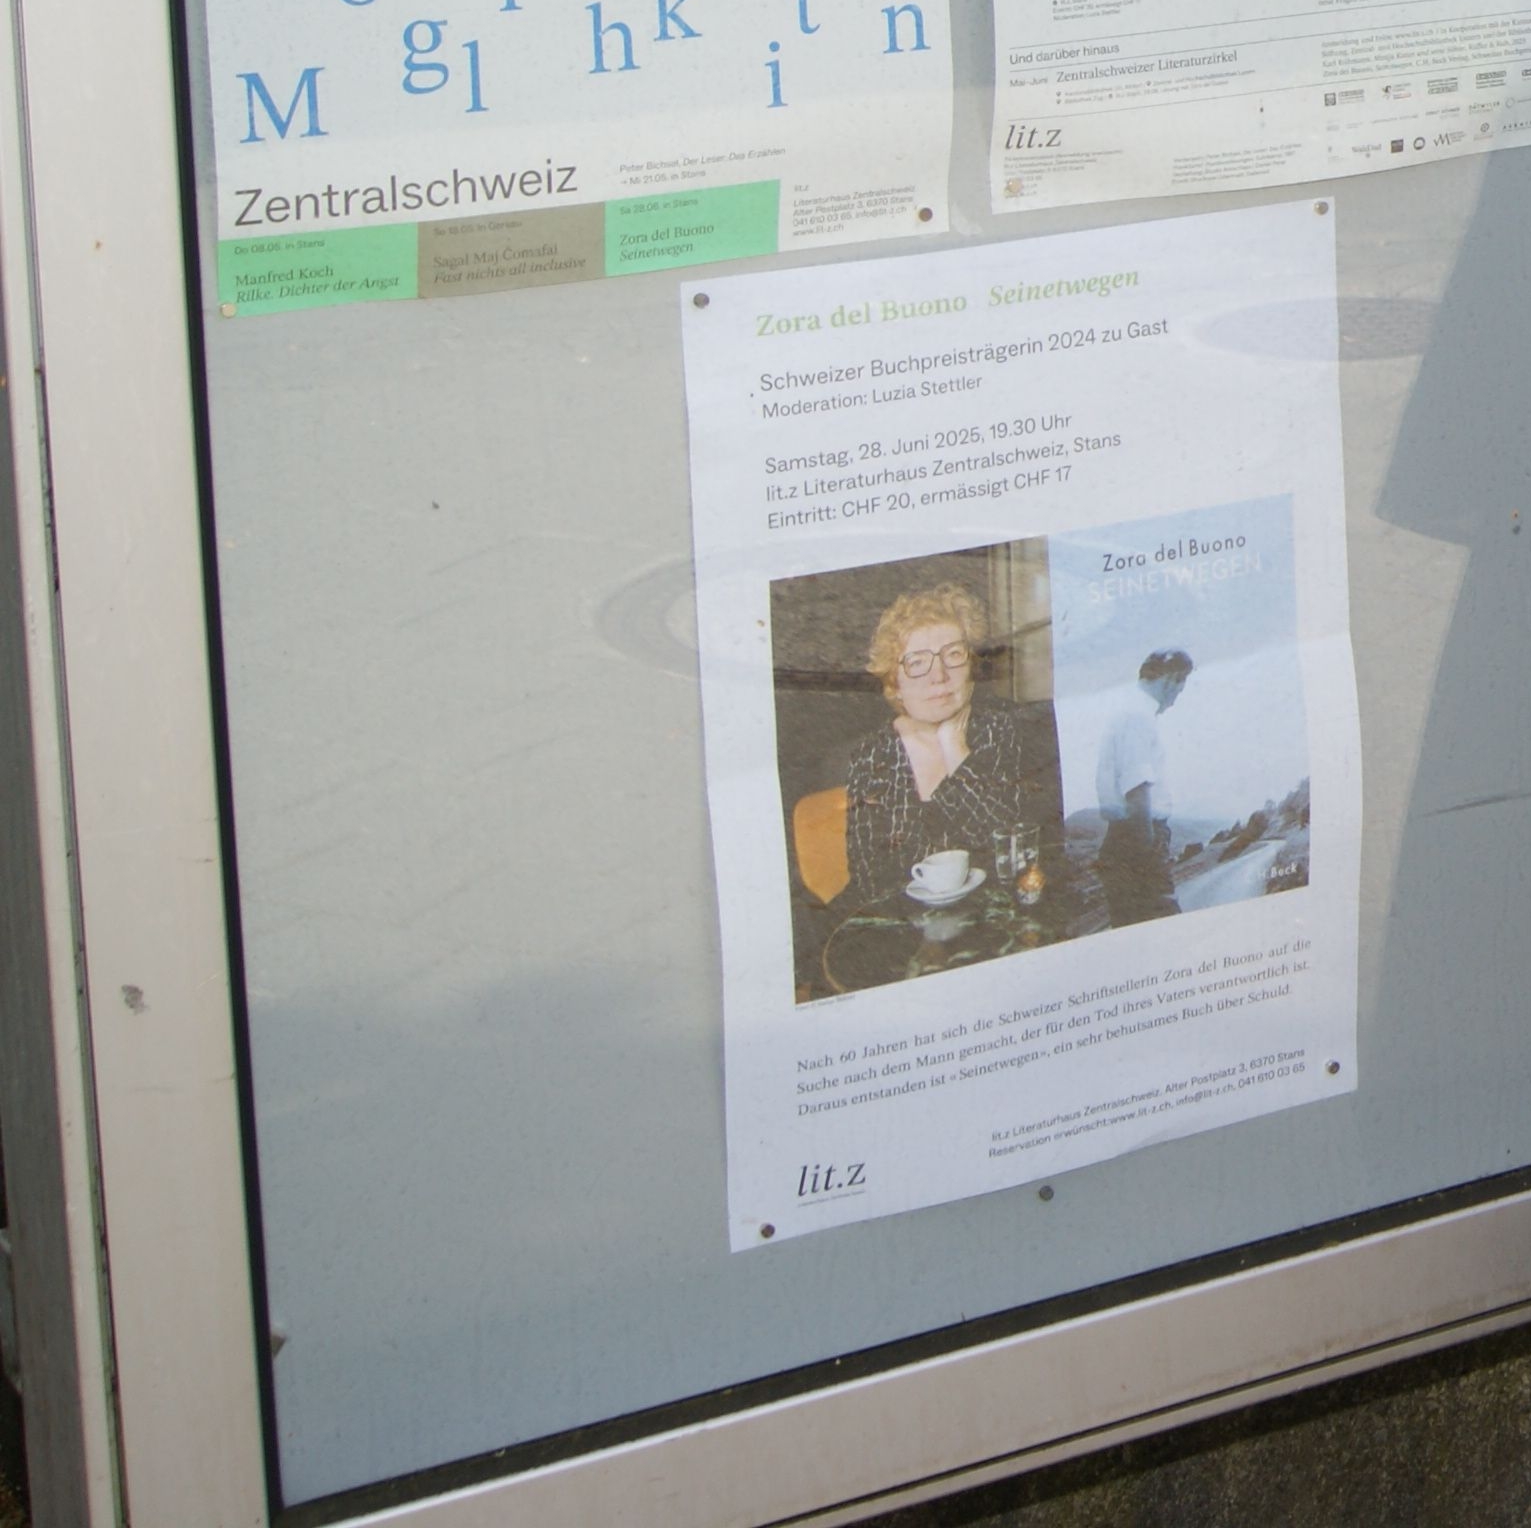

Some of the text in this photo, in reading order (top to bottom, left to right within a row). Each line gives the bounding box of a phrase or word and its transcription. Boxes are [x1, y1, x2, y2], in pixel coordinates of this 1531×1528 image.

[1010, 44, 1120, 65] Und darüber hinaus
[1057, 49, 1237, 83] Zentralschweizer Literaturzirkel
[1004, 124, 1063, 150] lit.z
[235, 158, 577, 227] Zentralschweiz
[620, 224, 714, 247] Zora del Buono
[236, 265, 333, 288] Manfred Koch
[756, 271, 1139, 337] Zora del Buono Seinetwegen
[760, 318, 1168, 392] Schweizer Buchpreisträgerin 2024 zu Gast
[763, 376, 982, 419] Moderation: Luzia Stettler
[766, 413, 1072, 474] Samstag, 28. Juni 2025, 19.30 Uhr
[767, 434, 1121, 502] lit.z Literaturhaus Zentralschweiz, Stans
[768, 465, 1072, 530] Eintritt: CHF 20, ermässigt CHF 17
[1103, 535, 1246, 573] Zora del Buono
[797, 940, 1311, 1073] Nach 60 Jahren hat sich die Schweizer Schriftstellerin Zora del Buono auf die
[797, 961, 1309, 1095] Suche nach dem Mann gemacht, der für den Tod ihres Vaters verantwortlich ist.
[798, 1098, 847, 1117] Daraus
[851, 1080, 926, 1105] entstanden
[931, 1074, 945, 1088] ist
[1054, 1041, 1072, 1055] ein
[1077, 1032, 1102, 1049] sehr
[1106, 1013, 1178, 1041] behutsames
[1182, 1002, 1213, 1020] Buch
[1217, 997, 1243, 1012] über
[796, 1162, 867, 1198] lit.z
